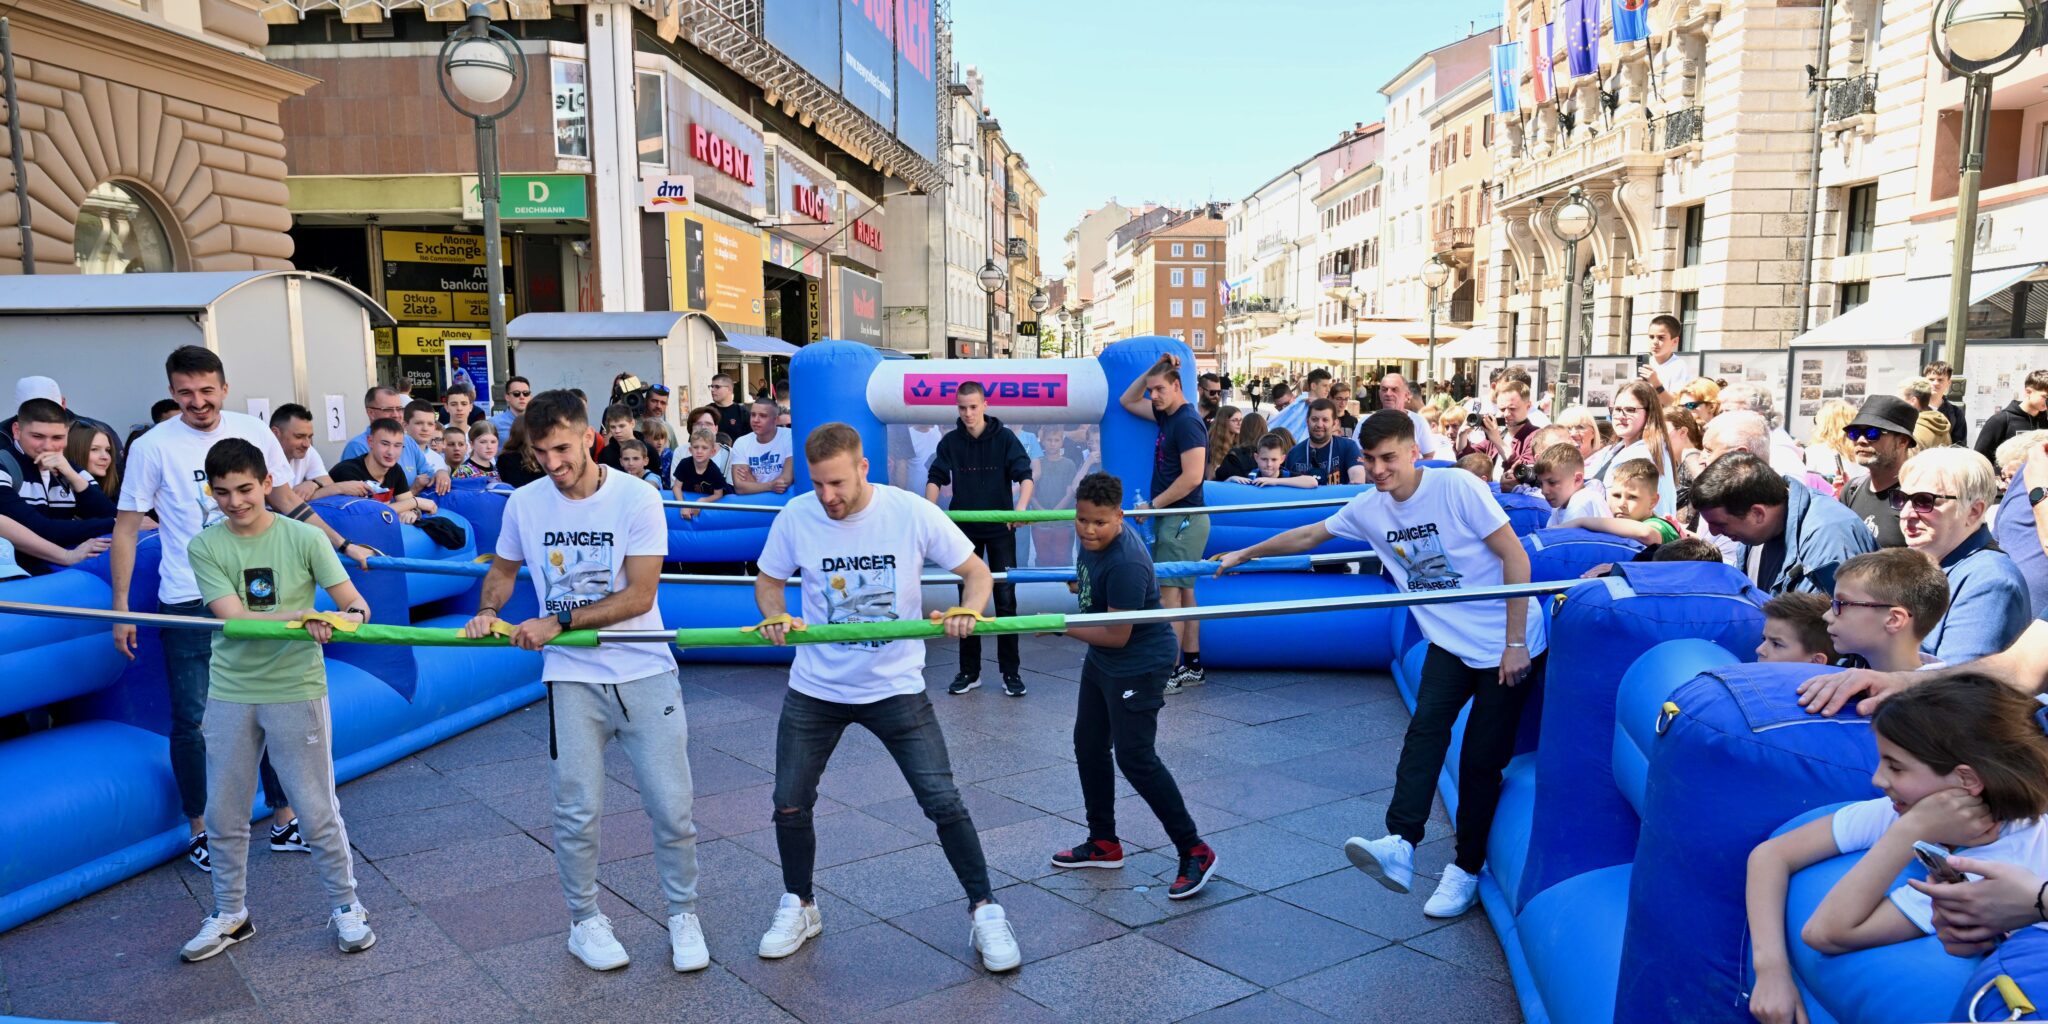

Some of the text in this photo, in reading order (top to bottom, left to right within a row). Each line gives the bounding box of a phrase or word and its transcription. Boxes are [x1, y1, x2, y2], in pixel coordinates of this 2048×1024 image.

[690, 122, 755, 187] ROBNA
[528, 181, 549, 203] D
[657, 181, 684, 196] dm
[514, 206, 565, 214] DEICHMANN
[443, 235, 478, 247] Money
[415, 242, 482, 259] Exchange
[473, 267, 488, 278] AT
[441, 278, 488, 291] bankom
[403, 293, 436, 304] Otkup
[403, 303, 438, 315] Zlata
[470, 305, 488, 316] Zla
[809, 283, 818, 329] OTKUP
[417, 336, 445, 347] Exch
[441, 330, 472, 340] Money
[407, 370, 431, 378] Otkup
[940, 381, 1060, 399] FVBET
[332, 407, 340, 429] 3
[543, 531, 614, 547] DANGER
[1386, 522, 1439, 543] DANGER
[821, 554, 896, 573] DANGER
[1408, 578, 1461, 590] BEWARE OF
